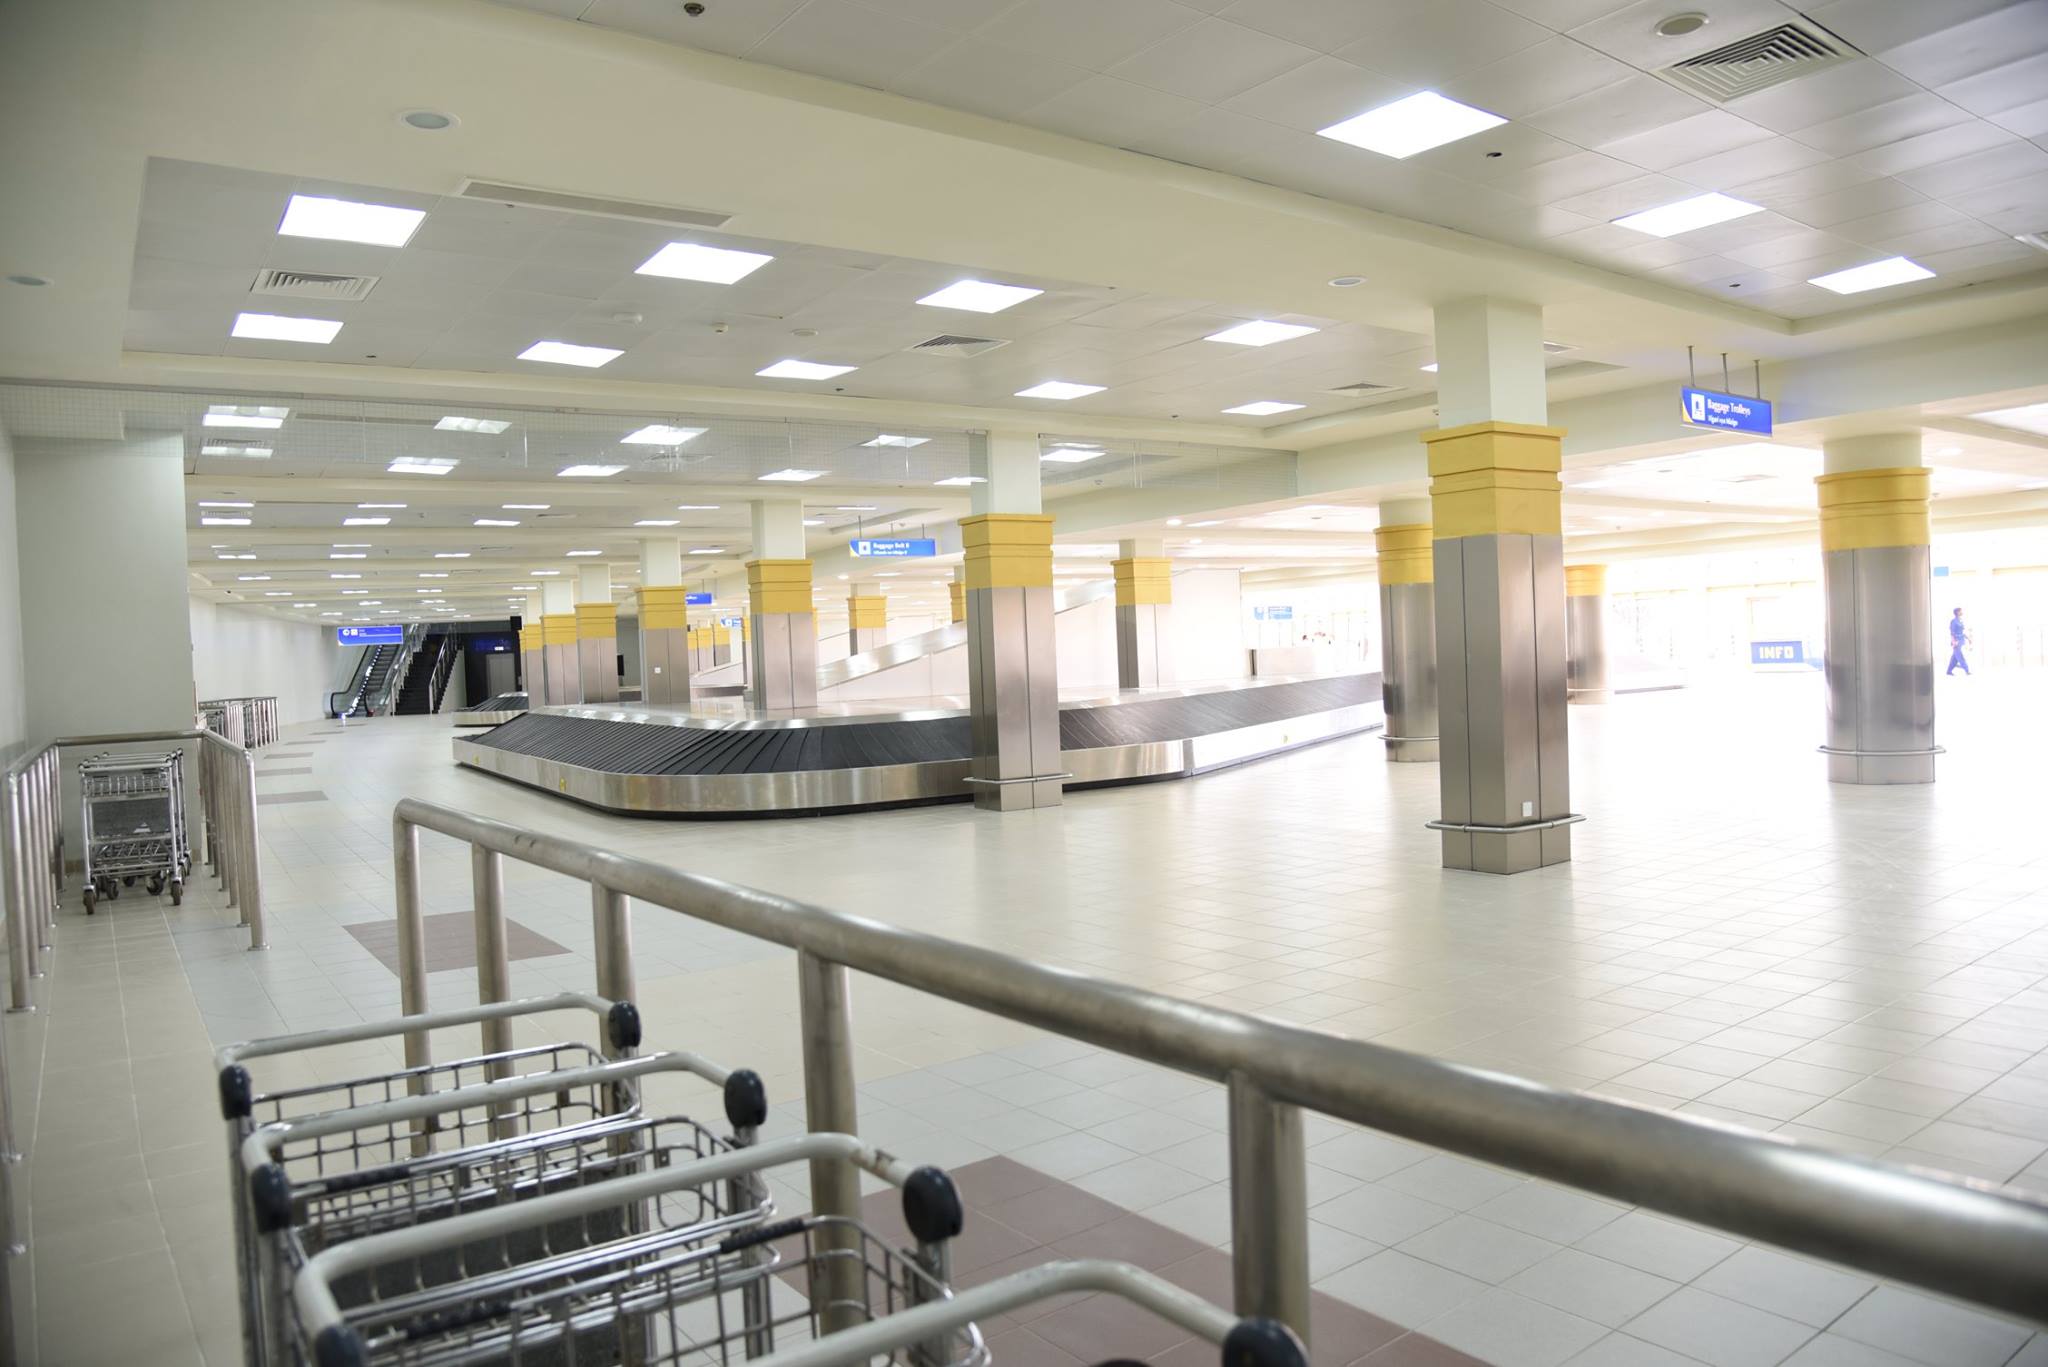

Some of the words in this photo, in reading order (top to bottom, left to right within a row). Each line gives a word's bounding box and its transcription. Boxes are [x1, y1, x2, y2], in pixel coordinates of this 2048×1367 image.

[1707, 398, 1730, 414] Baggage
[1730, 402, 1751, 418] Trolleys
[1759, 645, 1794, 659] INFO
